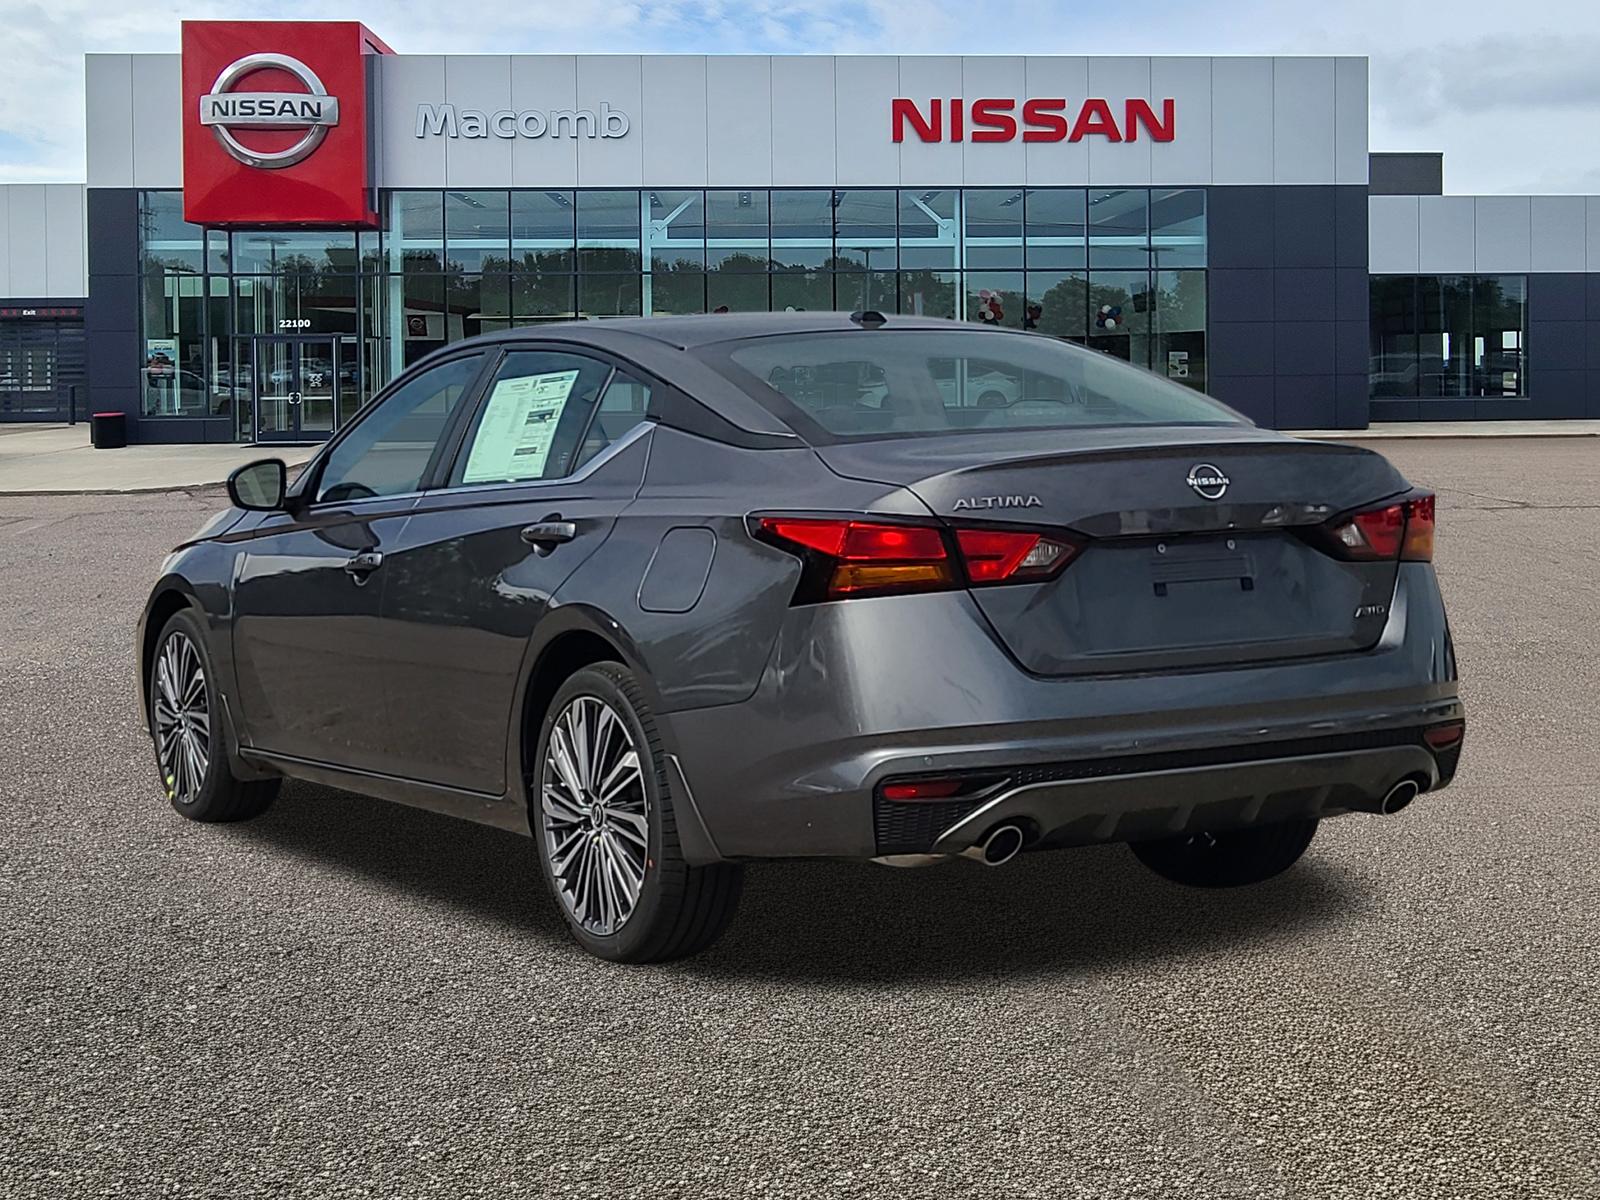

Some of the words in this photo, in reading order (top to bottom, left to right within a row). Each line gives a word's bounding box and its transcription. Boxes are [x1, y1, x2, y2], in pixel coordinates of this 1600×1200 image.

[211, 100, 322, 118] NISSAN
[415, 101, 630, 139] Macomb
[891, 98, 1175, 143] NISSAN
[279, 319, 311, 328] 22100
[1186, 477, 1230, 486] NISSAN
[952, 495, 1043, 511] ALTIMA
